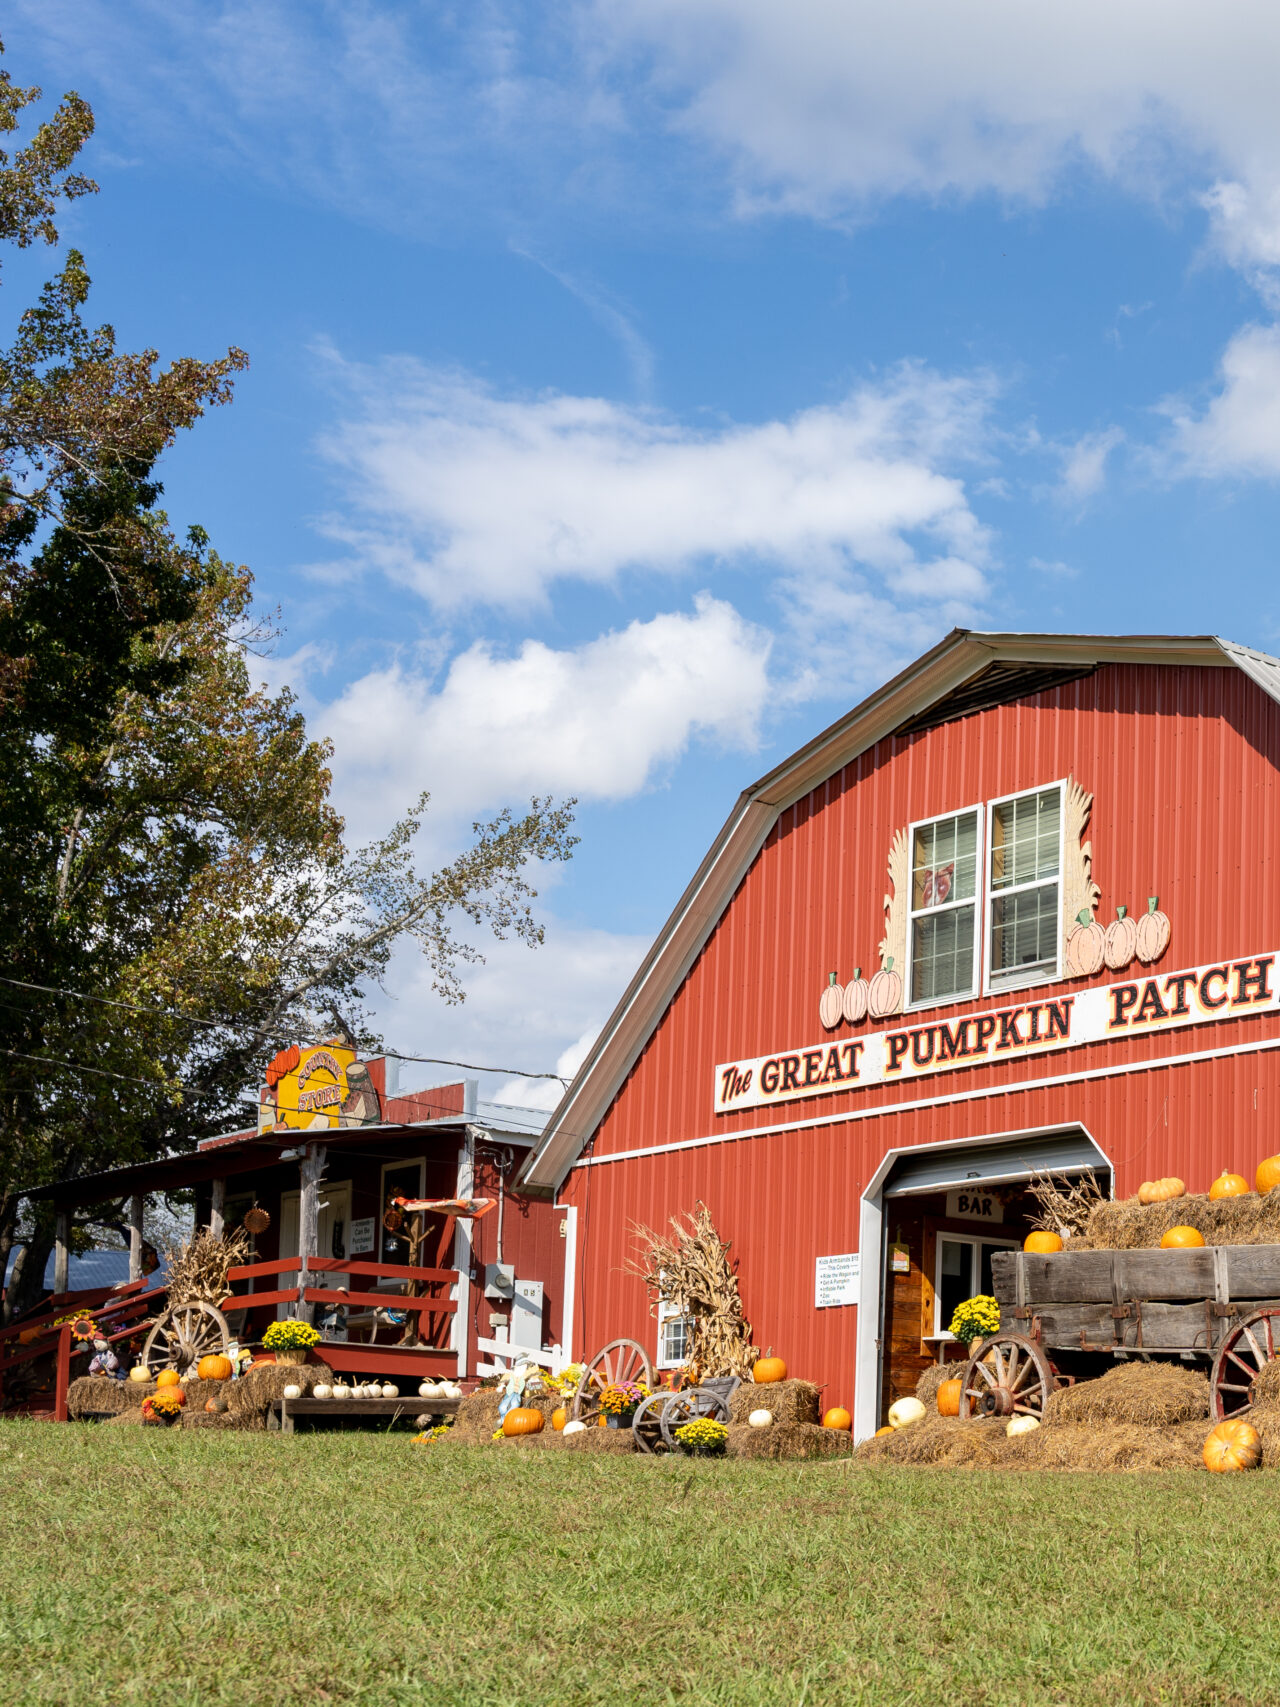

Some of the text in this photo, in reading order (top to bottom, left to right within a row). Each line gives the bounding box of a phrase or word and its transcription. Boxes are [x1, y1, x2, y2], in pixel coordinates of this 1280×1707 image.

[721, 1065, 754, 1103] The
[759, 1040, 865, 1096] GREAT
[885, 996, 1075, 1072] PUMPKIN
[1108, 954, 1275, 1030] PATCH
[298, 1051, 344, 1089] COUNTRY
[298, 1083, 342, 1110] STORE
[957, 1195, 993, 1217] BAR
